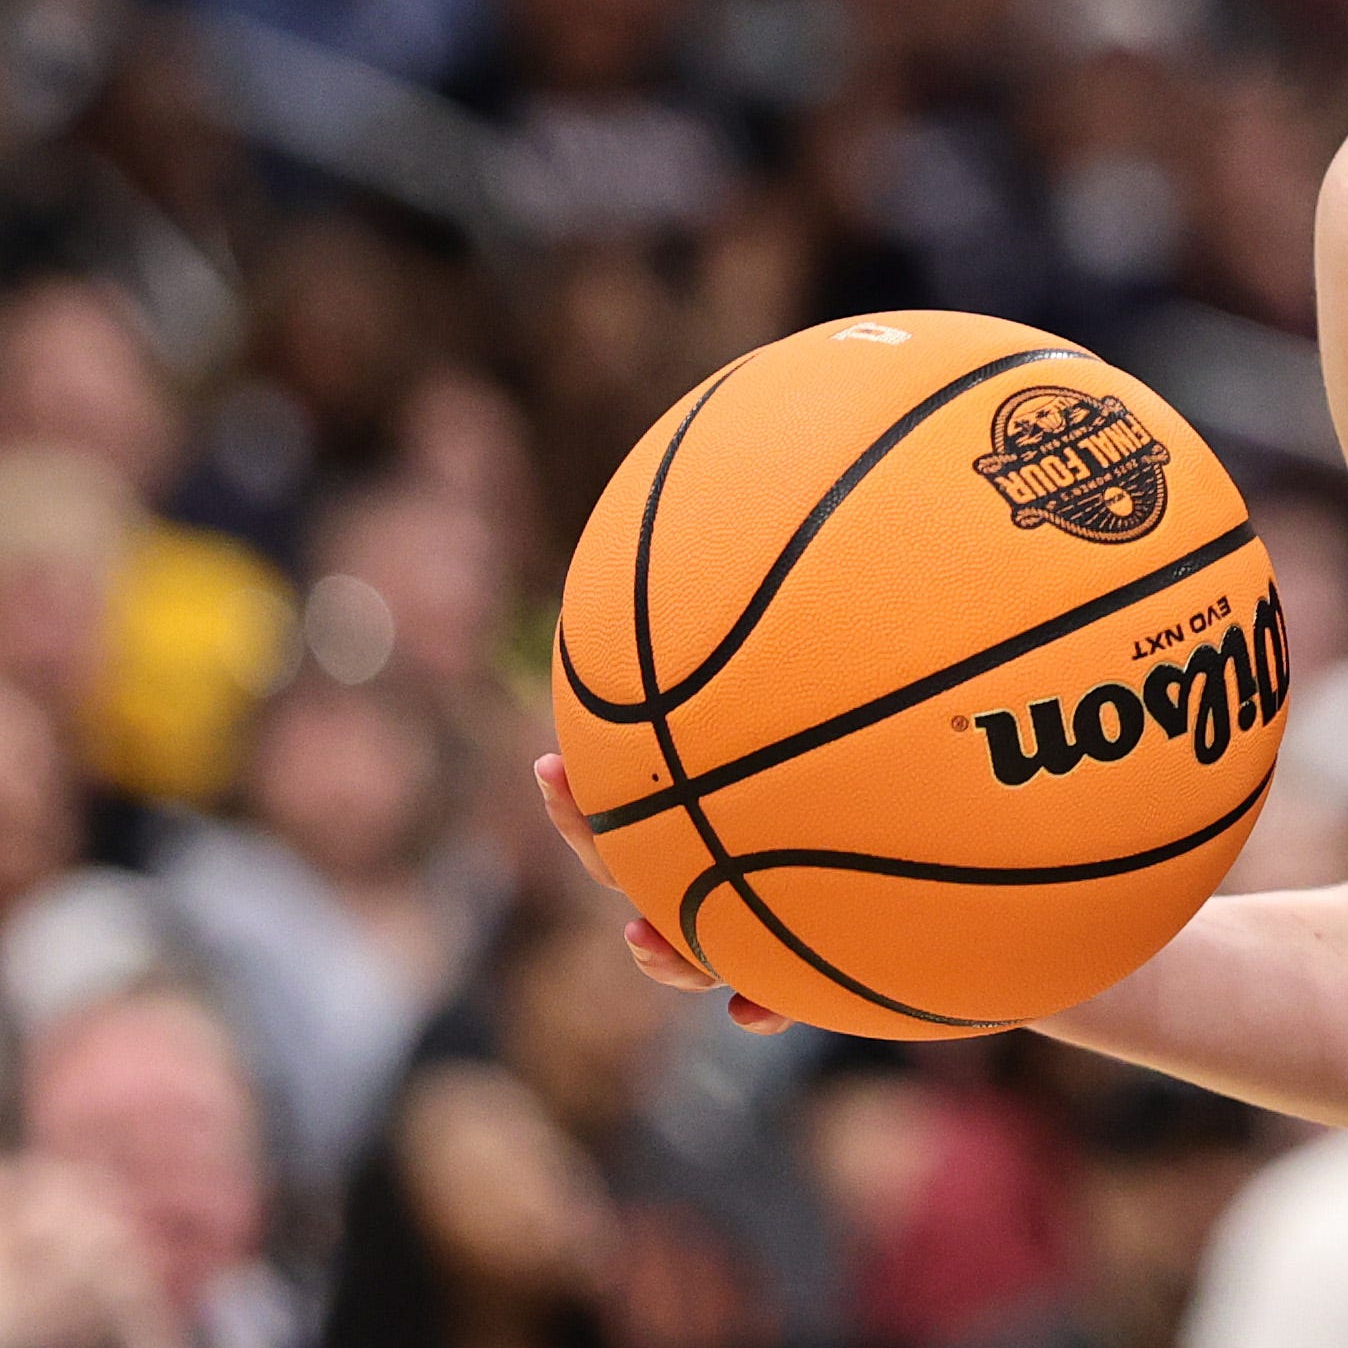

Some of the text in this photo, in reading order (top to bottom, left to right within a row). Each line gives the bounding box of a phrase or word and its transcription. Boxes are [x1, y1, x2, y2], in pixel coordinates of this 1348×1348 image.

[993, 412, 1152, 505] FINAL FOUR
[1130, 595, 1232, 661] EVO NXT
[974, 577, 1290, 787] Wilson
